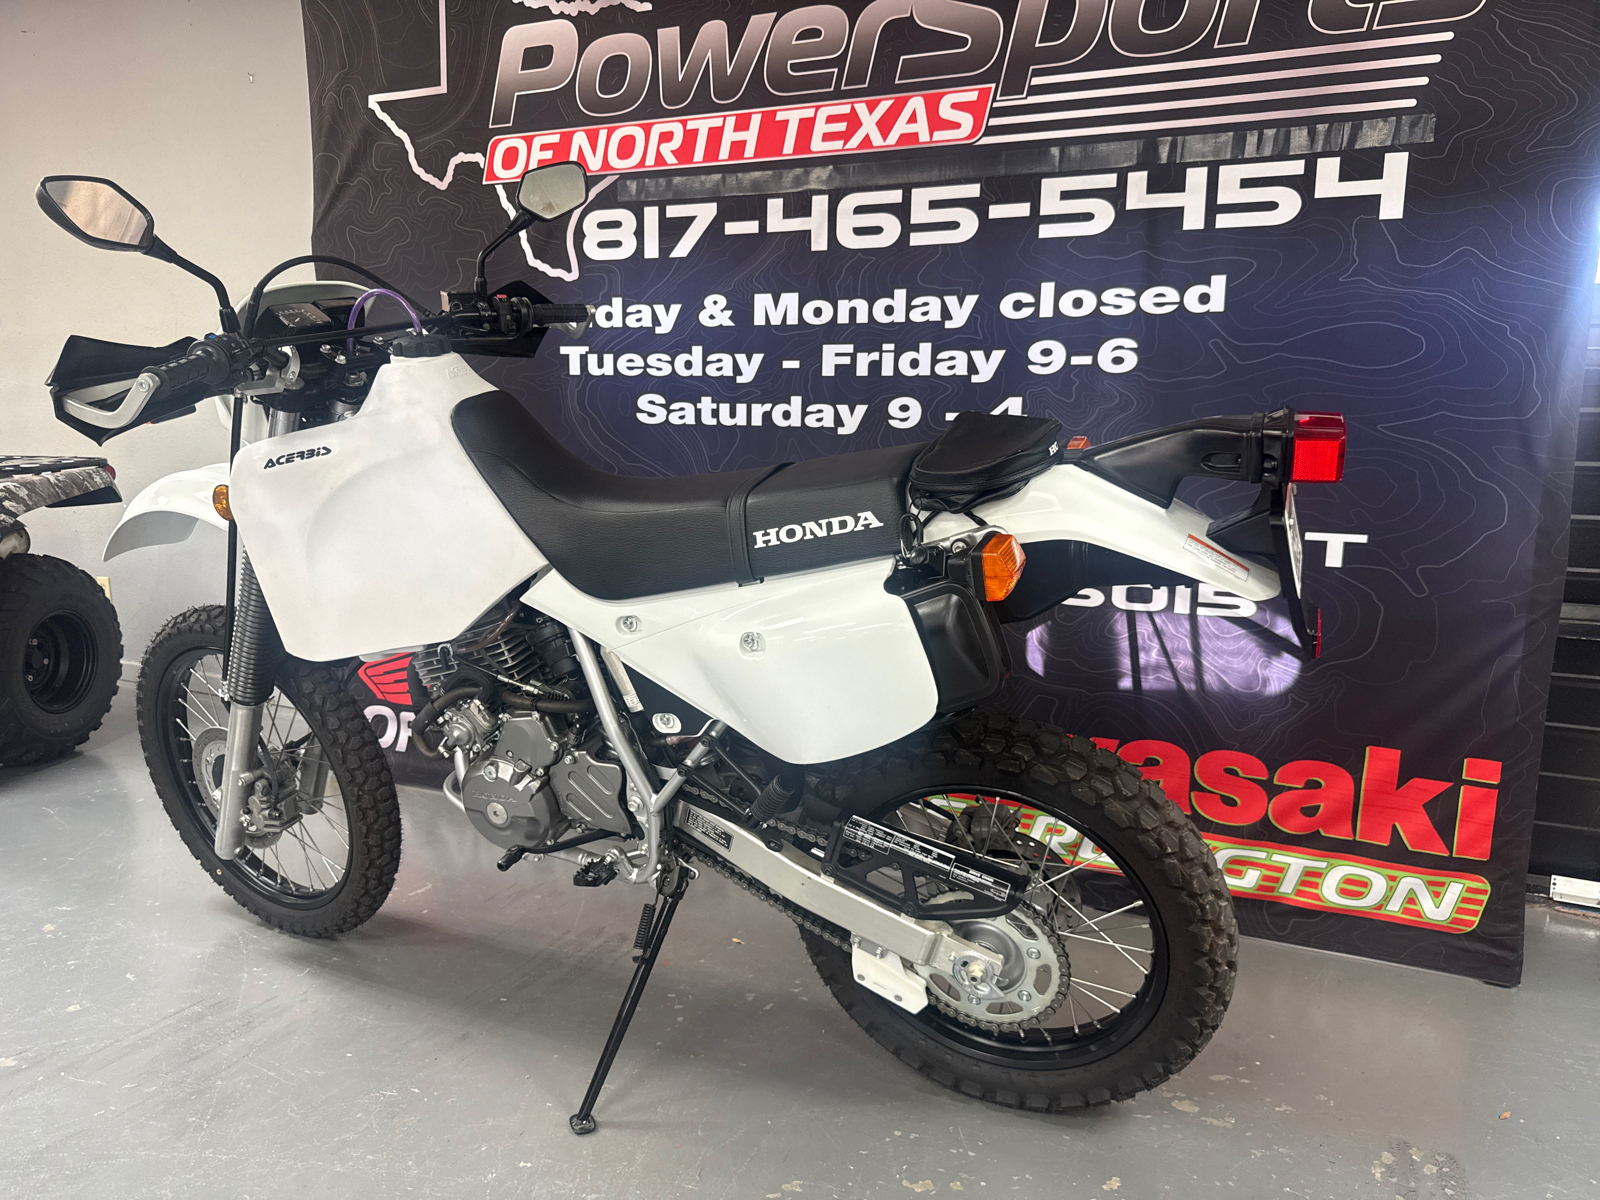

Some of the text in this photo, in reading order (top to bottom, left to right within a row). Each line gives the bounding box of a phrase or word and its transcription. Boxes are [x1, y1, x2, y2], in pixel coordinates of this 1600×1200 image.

[493, 90, 979, 179] OF NORTH TEXAS
[582, 151, 1410, 261] 817-465-5454
[588, 274, 1227, 335] day & Monday closed
[559, 337, 1138, 384] Tuesday - Friday 9-6
[635, 393, 869, 435] Saturday
[887, 396, 922, 429] 9
[753, 510, 884, 549] HONDA
